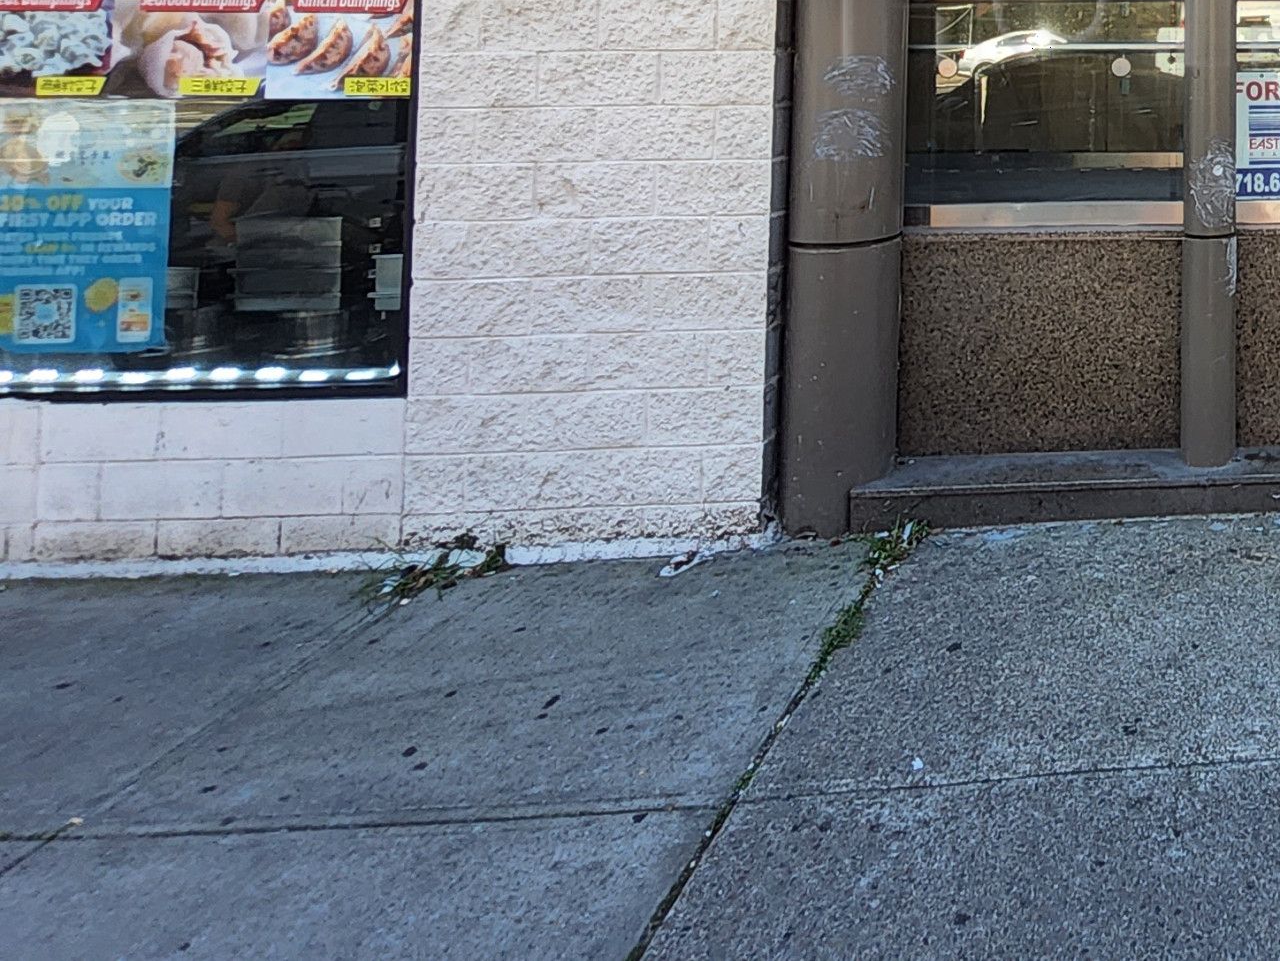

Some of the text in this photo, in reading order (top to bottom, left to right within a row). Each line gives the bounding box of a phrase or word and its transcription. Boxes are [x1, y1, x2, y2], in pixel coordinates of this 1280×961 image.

[1249, 137, 1280, 150] EAST
[88, 197, 134, 211] YOUR
[95, 211, 157, 226] ORDER
